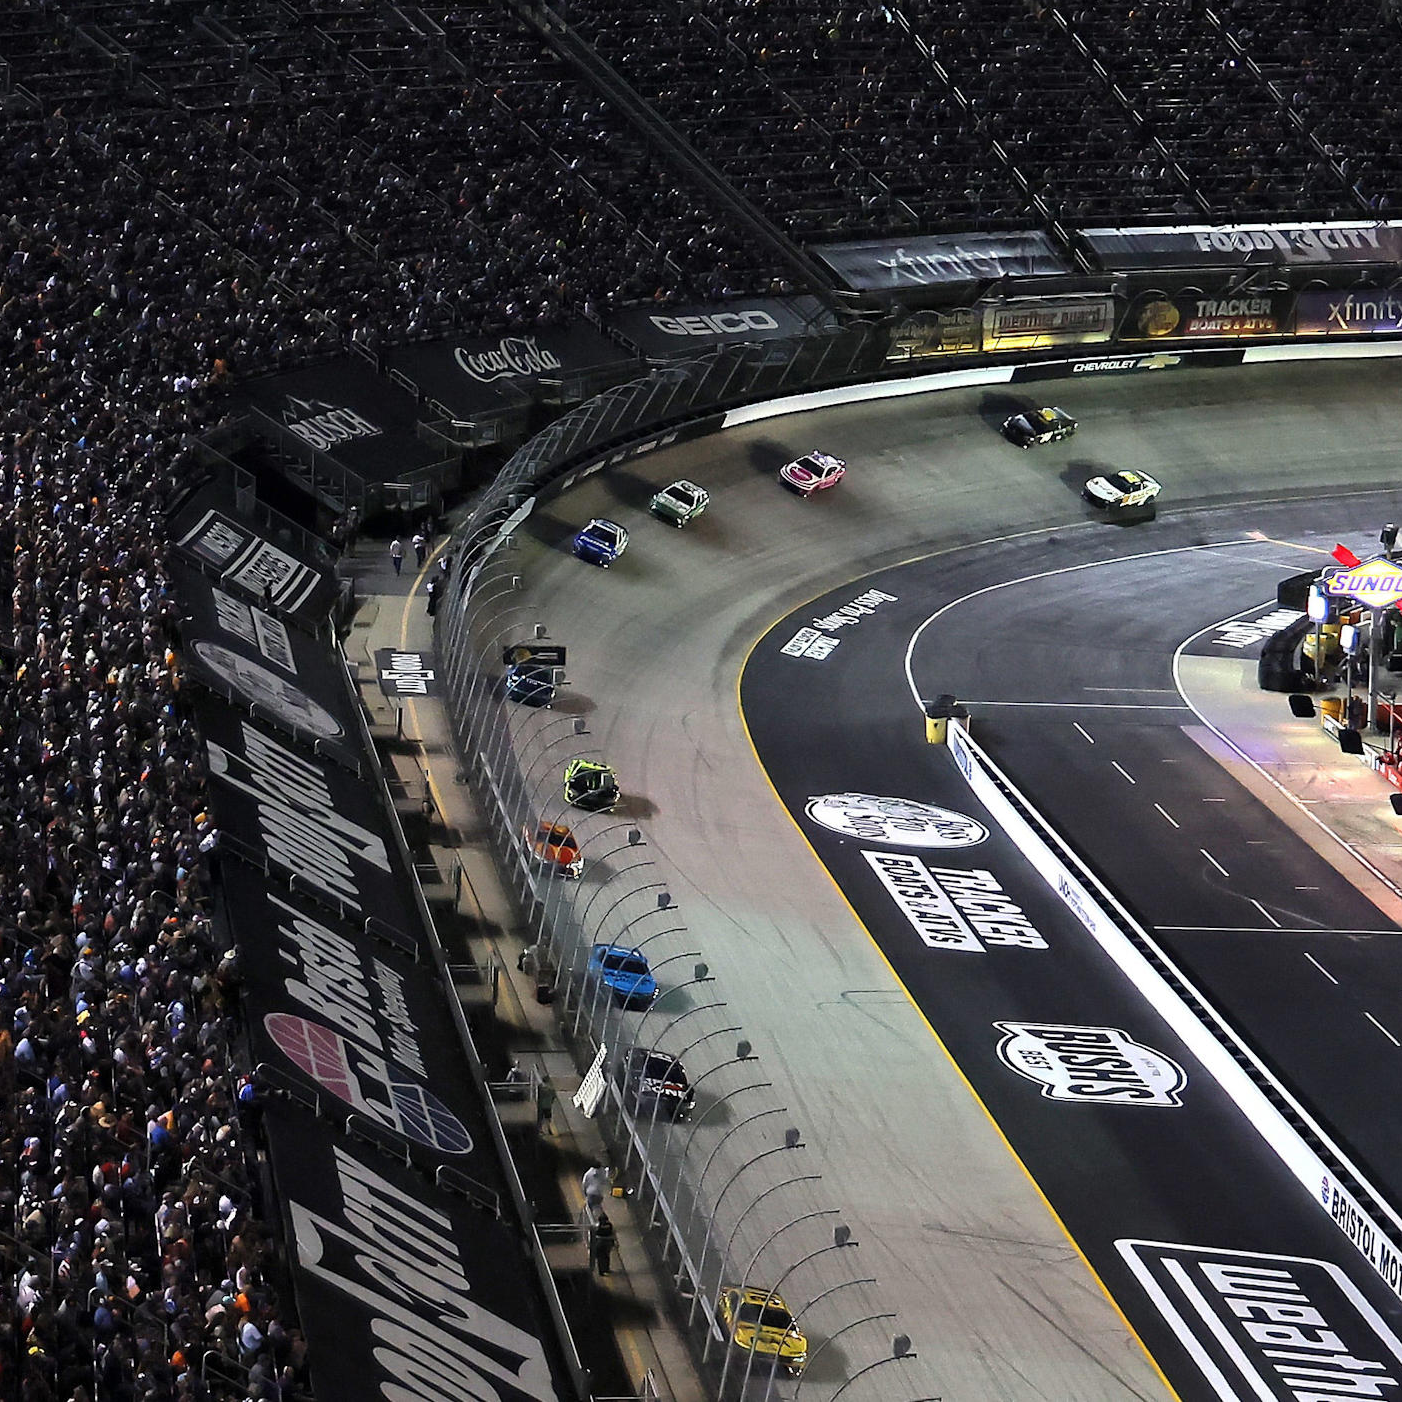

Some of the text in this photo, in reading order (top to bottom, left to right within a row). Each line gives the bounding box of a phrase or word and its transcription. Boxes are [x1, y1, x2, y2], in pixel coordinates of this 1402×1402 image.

[1194, 230, 1275, 252] FOOD
[1318, 229, 1381, 250] CITY
[649, 310, 781, 336] GEICO
[1189, 318, 1232, 331] BOATS
[1196, 298, 1272, 317] TRACKER
[1073, 359, 1137, 374] CHEVROLET
[289, 405, 384, 452] BUSCH
[240, 720, 334, 808] CITY
[257, 802, 363, 912] FOOD
[875, 856, 940, 903] BOATS
[911, 909, 970, 945] ATVs
[927, 865, 1051, 951] TRACKER
[267, 893, 384, 1051] Bristol
[1018, 1049, 1054, 1071] BEST
[1021, 1028, 1156, 1099] BUSH'S
[332, 1145, 473, 1293] CITY
[1331, 1188, 1378, 1268] BRISTOL
